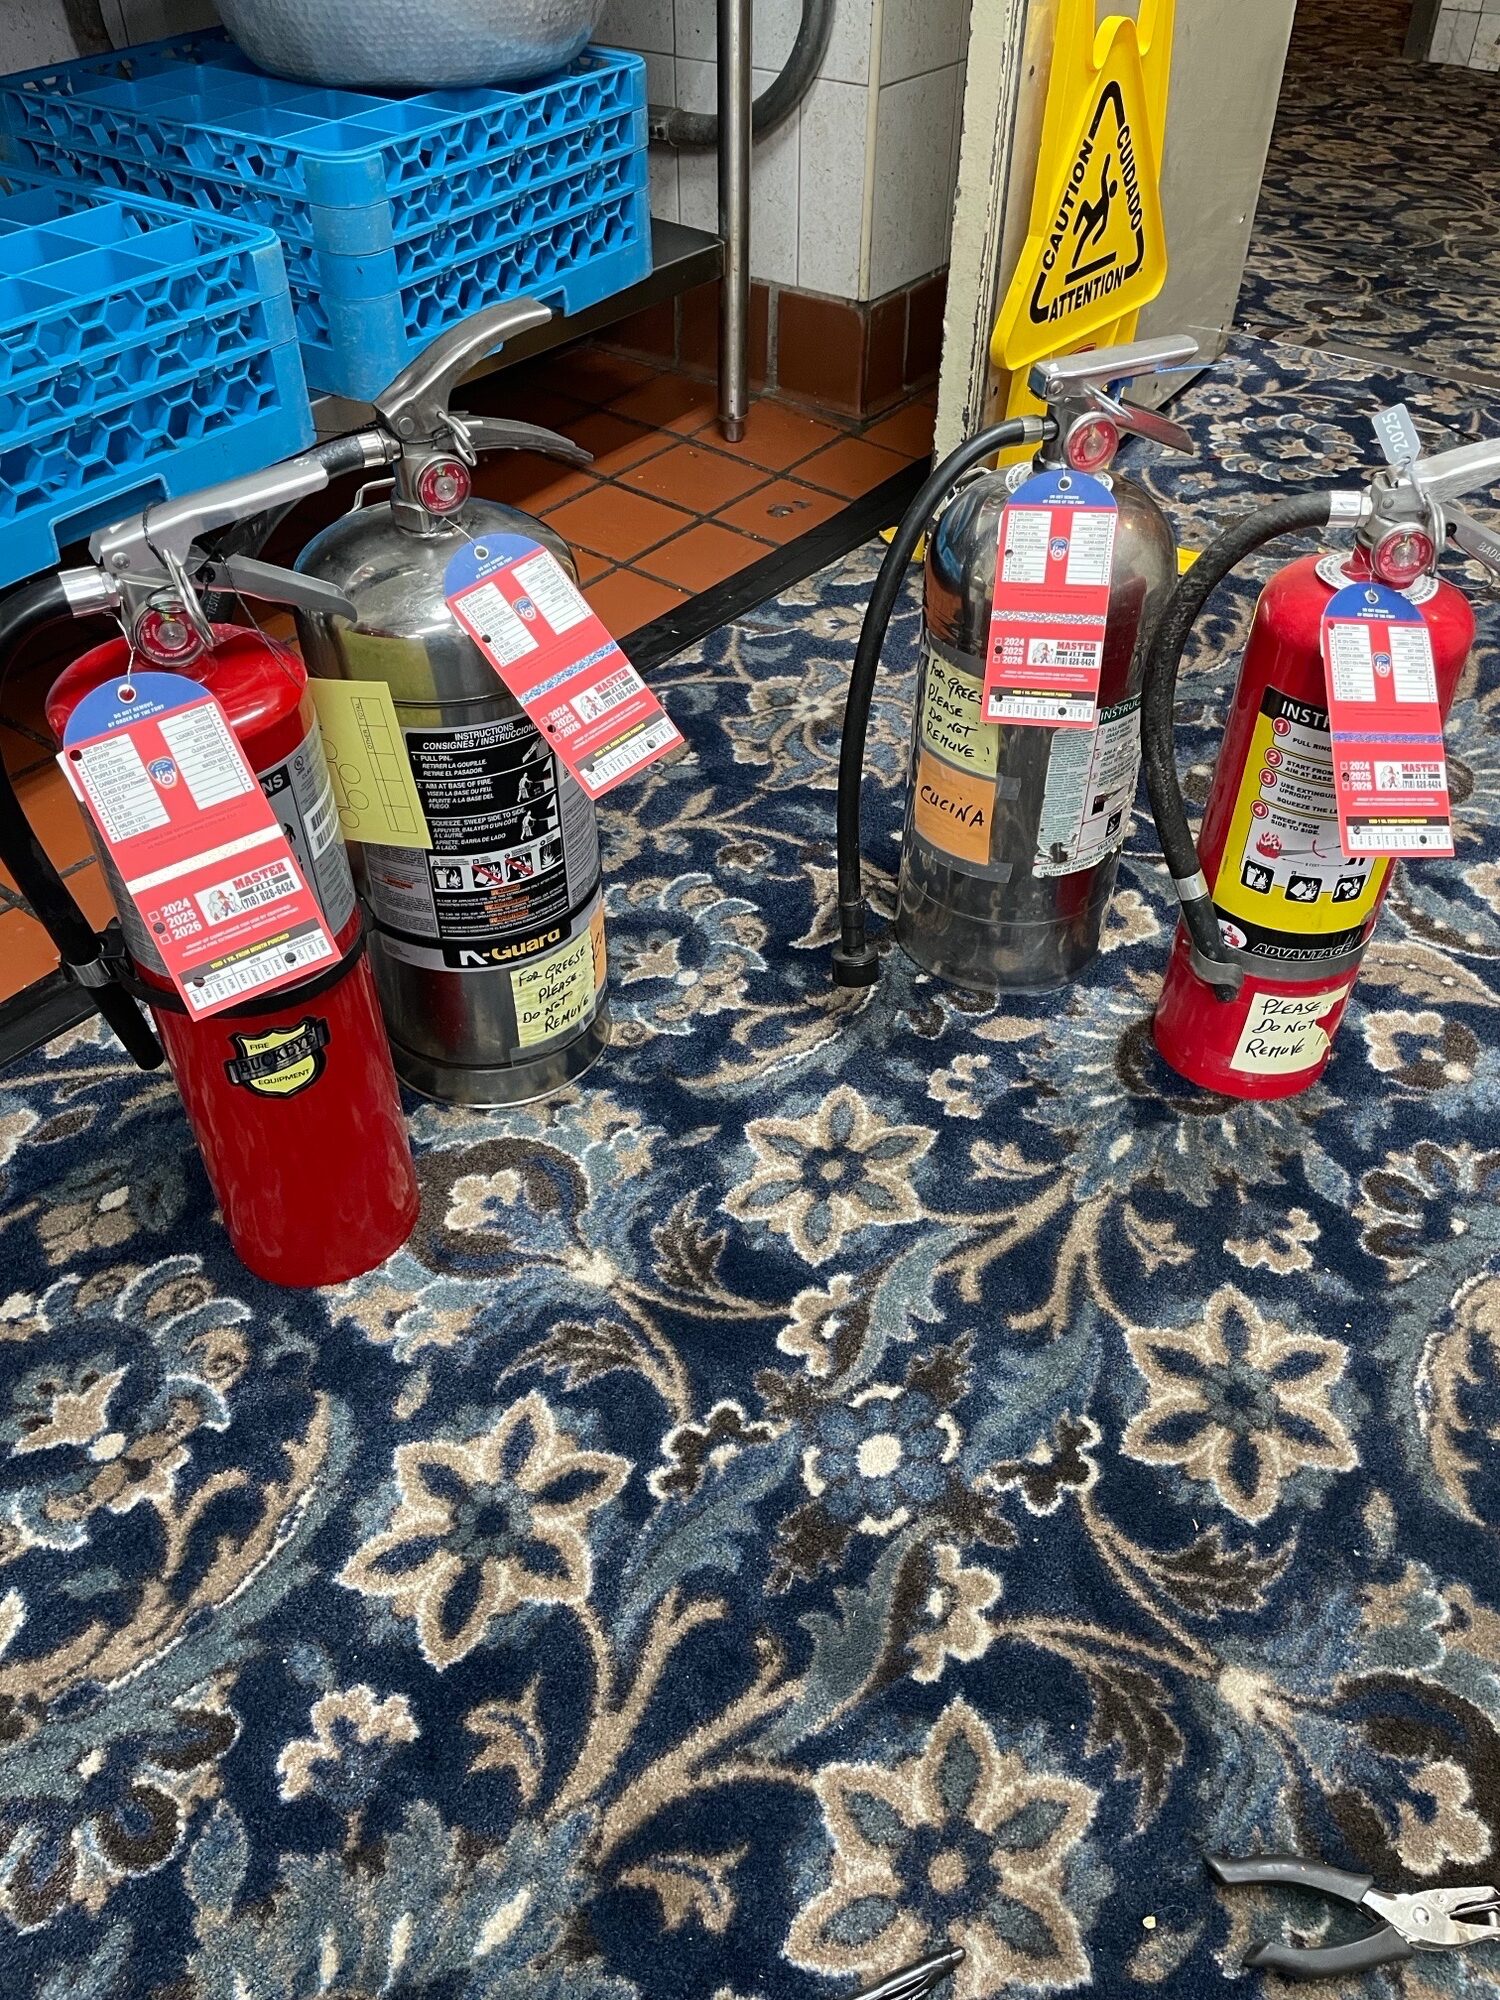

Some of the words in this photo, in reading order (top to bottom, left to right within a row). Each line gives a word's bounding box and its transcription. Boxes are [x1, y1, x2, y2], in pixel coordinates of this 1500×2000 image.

[1117, 125, 1143, 231] CUIDADO
[1042, 140, 1094, 270] CAUTION
[1048, 264, 1124, 323] ATTENTION
[1382, 411, 1409, 453] 2025
[1003, 637, 1024, 646] 2024
[1056, 641, 1096, 651] MASTER
[1002, 646, 1023, 655] 2025
[1001, 655, 1022, 664] 2026
[930, 658, 946, 685] FOR
[593, 668, 631, 694] MASTER
[131, 700, 153, 711] REMOVE
[547, 703, 569, 720] 2024
[114, 715, 133, 725] ORDER
[553, 711, 576, 729] 2025
[929, 707, 942, 723] DO
[947, 723, 978, 738] NOT
[1278, 722, 1284, 732] 1
[455, 723, 514, 741] INSTRUCTIONS
[559, 720, 582, 737] 2026
[423, 737, 474, 750] CONSIGNES
[1293, 738, 1310, 748] PULL
[1269, 753, 1277, 762] 2
[1287, 761, 1310, 772] START
[1349, 761, 1370, 770] 2024
[1401, 763, 1439, 772] MASTER
[1265, 772, 1272, 782] 3
[1285, 767, 1299, 775] AIM
[1312, 773, 1332, 782] BASE
[1350, 771, 1371, 780] 2025
[448, 781, 466, 789] BASE
[467, 780, 477, 788] OF
[1351, 781, 1372, 791] 2026
[466, 795, 482, 803] BASE
[483, 793, 494, 801] DEL
[1279, 788, 1313, 801] UPRIGHT.
[920, 785, 984, 828] CUCINA
[1255, 805, 1263, 814] 4
[1276, 797, 1310, 810] SQUEEZE
[1312, 805, 1328, 813] THE
[464, 817, 486, 825] SWEEP
[487, 814, 501, 822] SIDE
[1271, 819, 1287, 828] SIDE
[1304, 827, 1320, 835] SIDE.
[1272, 814, 1297, 825] SWEEP
[231, 861, 287, 890] MASTER
[239, 894, 260, 909] (718)
[258, 879, 296, 901] 828-6424
[159, 897, 192, 917] 2024
[165, 908, 197, 929] 2025
[170, 919, 203, 940] 2026
[1252, 942, 1351, 960] ADVANTAGE
[519, 970, 542, 987] FOR
[523, 1012, 539, 1023] DO
[545, 991, 573, 1016] NOT
[1252, 1019, 1280, 1034] DO
[1284, 1019, 1315, 1033] NOT
[258, 1069, 310, 1085] EQUIPMENT
